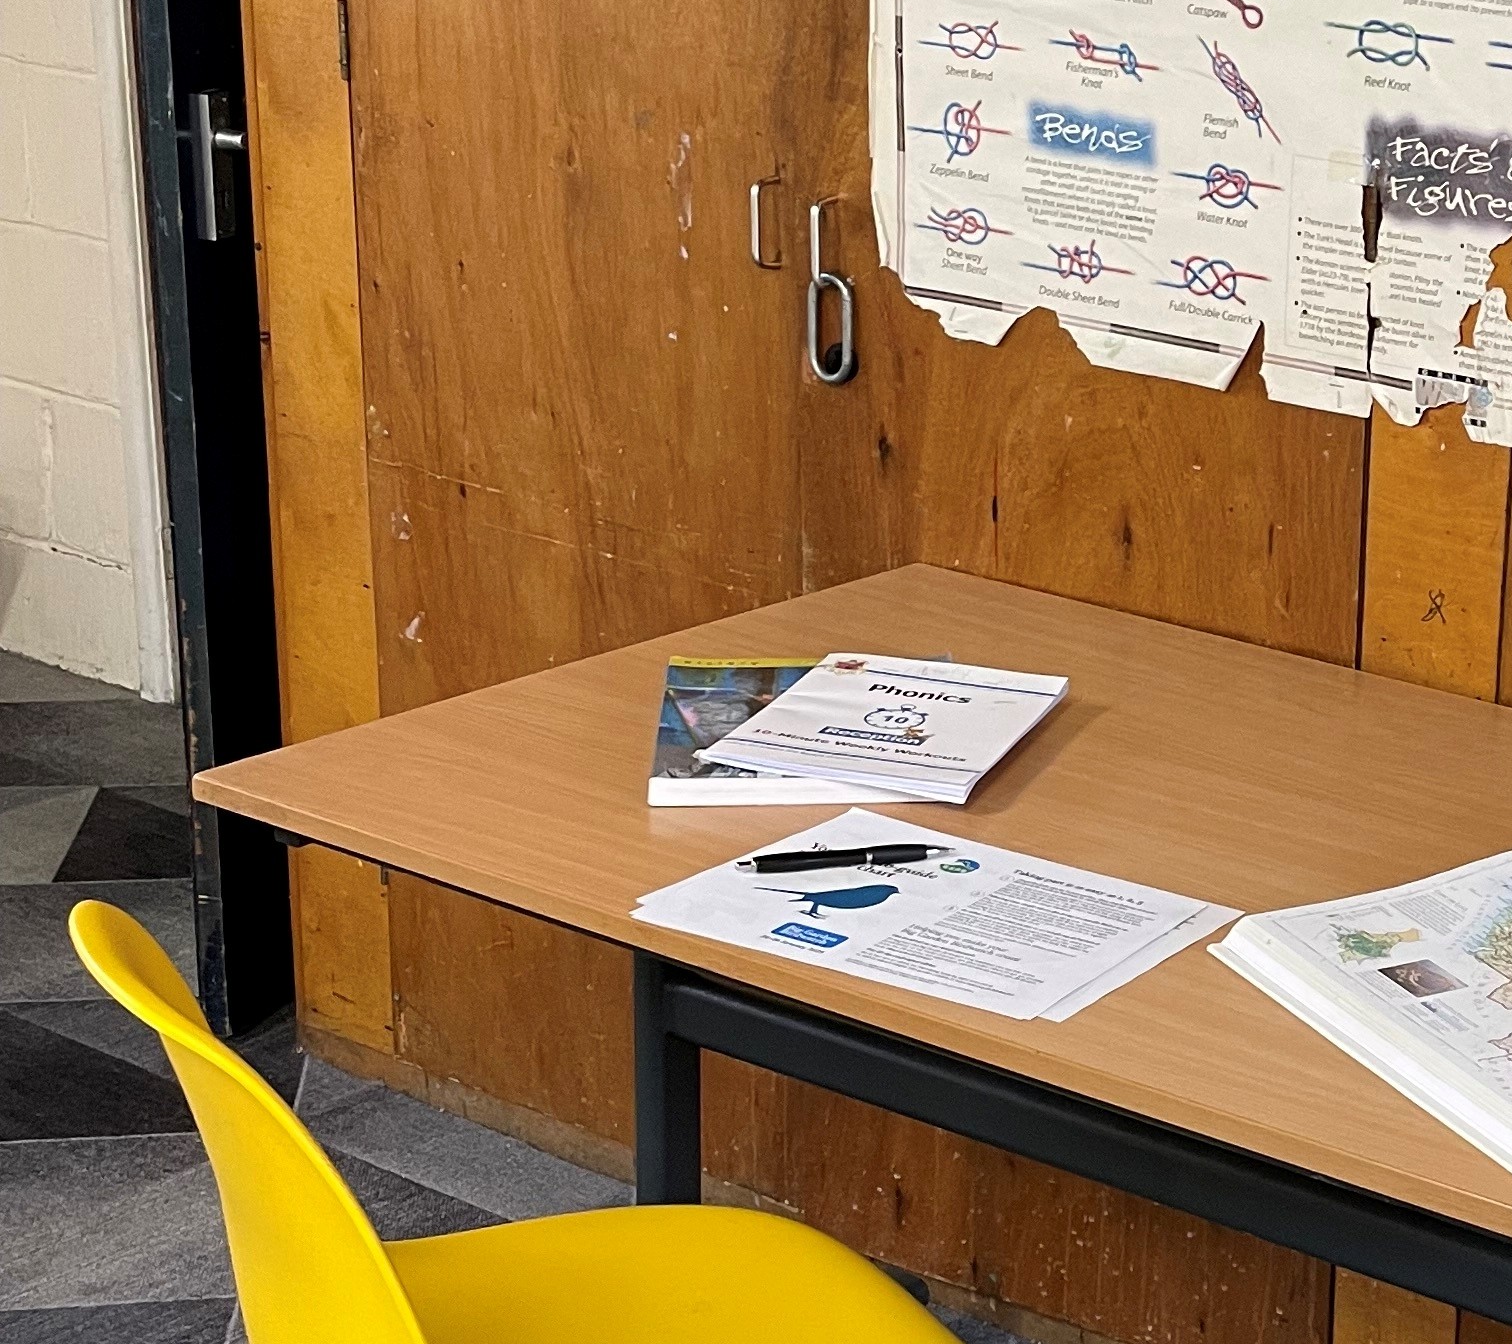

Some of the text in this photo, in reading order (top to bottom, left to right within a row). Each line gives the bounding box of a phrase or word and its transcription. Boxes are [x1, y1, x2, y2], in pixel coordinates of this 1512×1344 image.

[1187, 4, 1227, 19] Catspaw
[1066, 62, 1119, 79] Fisherman's
[1081, 77, 1103, 88] Knot
[1365, 76, 1411, 92] Reef Knot
[1036, 113, 1152, 152] Bends
[1197, 212, 1248, 228] Water Knot
[1039, 285, 1120, 308] Double Sheet Bend
[1169, 300, 1256, 325] Full/Double Carrick
[869, 683, 972, 704] Phonics
[883, 714, 909, 724] 10
[824, 727, 920, 746] Reception
